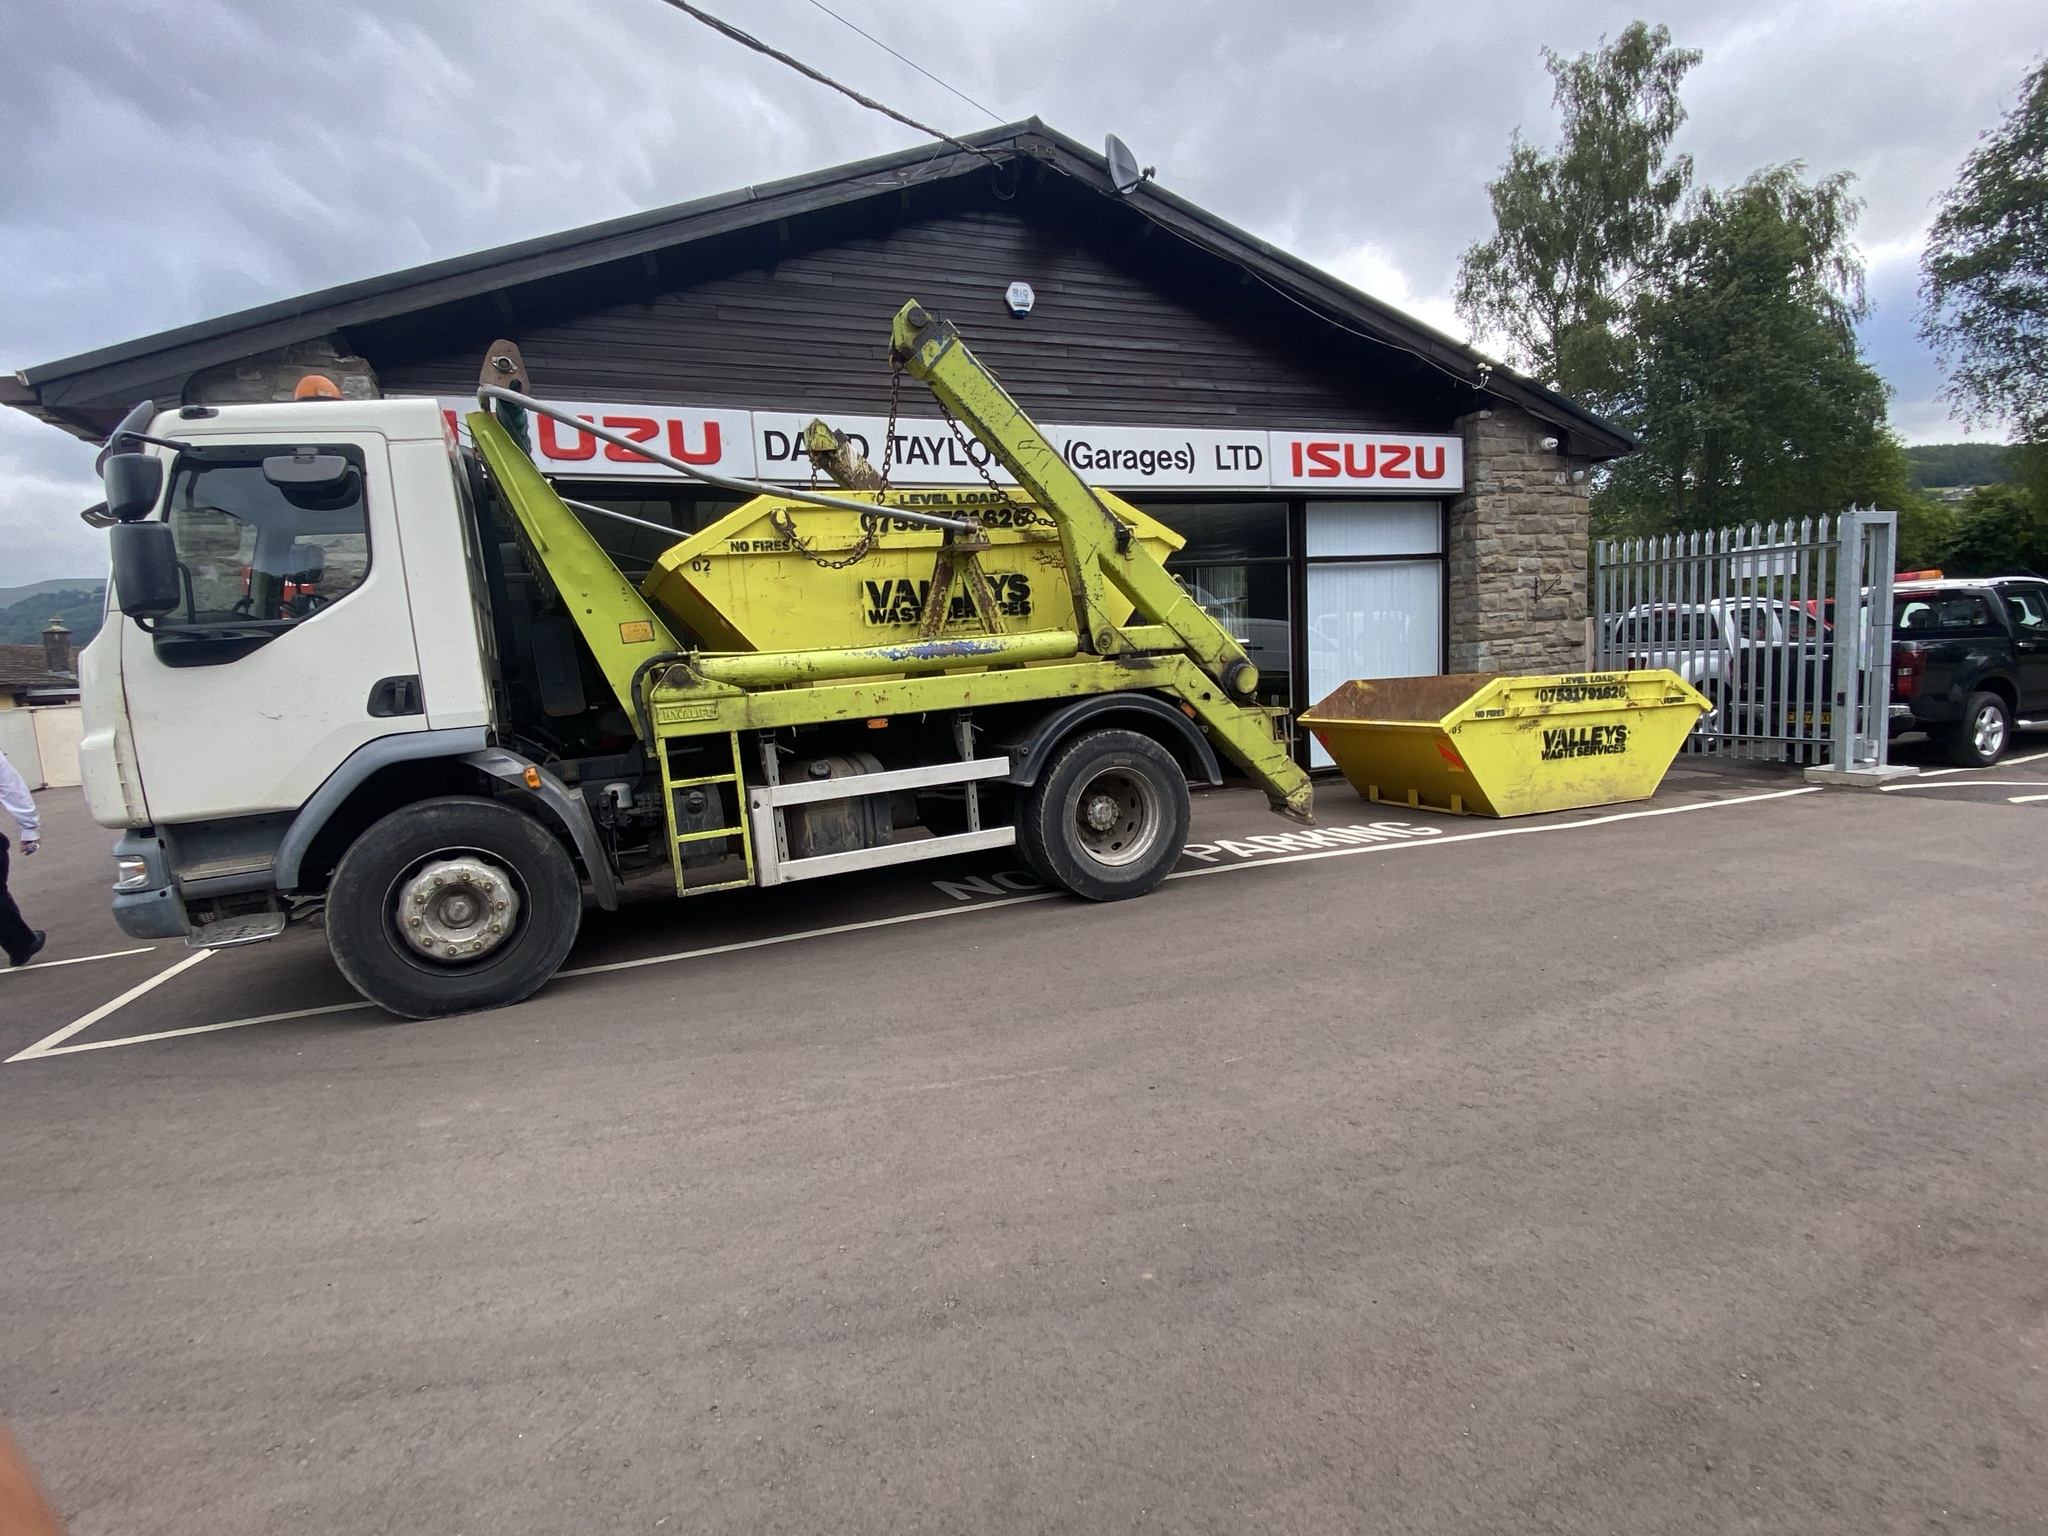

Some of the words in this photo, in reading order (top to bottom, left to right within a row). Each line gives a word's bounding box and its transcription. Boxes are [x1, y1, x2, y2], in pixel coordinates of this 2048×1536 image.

[891, 435, 1000, 467] TAYLO
[1064, 440, 1195, 475] (Garages)
[1215, 445, 1262, 470] LTD
[1291, 442, 1445, 479] ISUZU
[899, 493, 953, 505] LEVEL
[956, 493, 1001, 504] LOAD
[730, 541, 749, 552] NO
[752, 540, 790, 552] FIRES
[692, 559, 711, 572] 02
[865, 573, 1031, 609] VAYS
[868, 607, 924, 625] WAST
[1560, 676, 1588, 685] LEVEL
[1474, 710, 1485, 719] NO
[1542, 725, 1628, 750] VALLEYS
[1541, 747, 1575, 761] WASTE
[1577, 743, 1626, 757] SERVICES
[931, 870, 1050, 900] NO
[1182, 822, 1442, 862] PARKING
